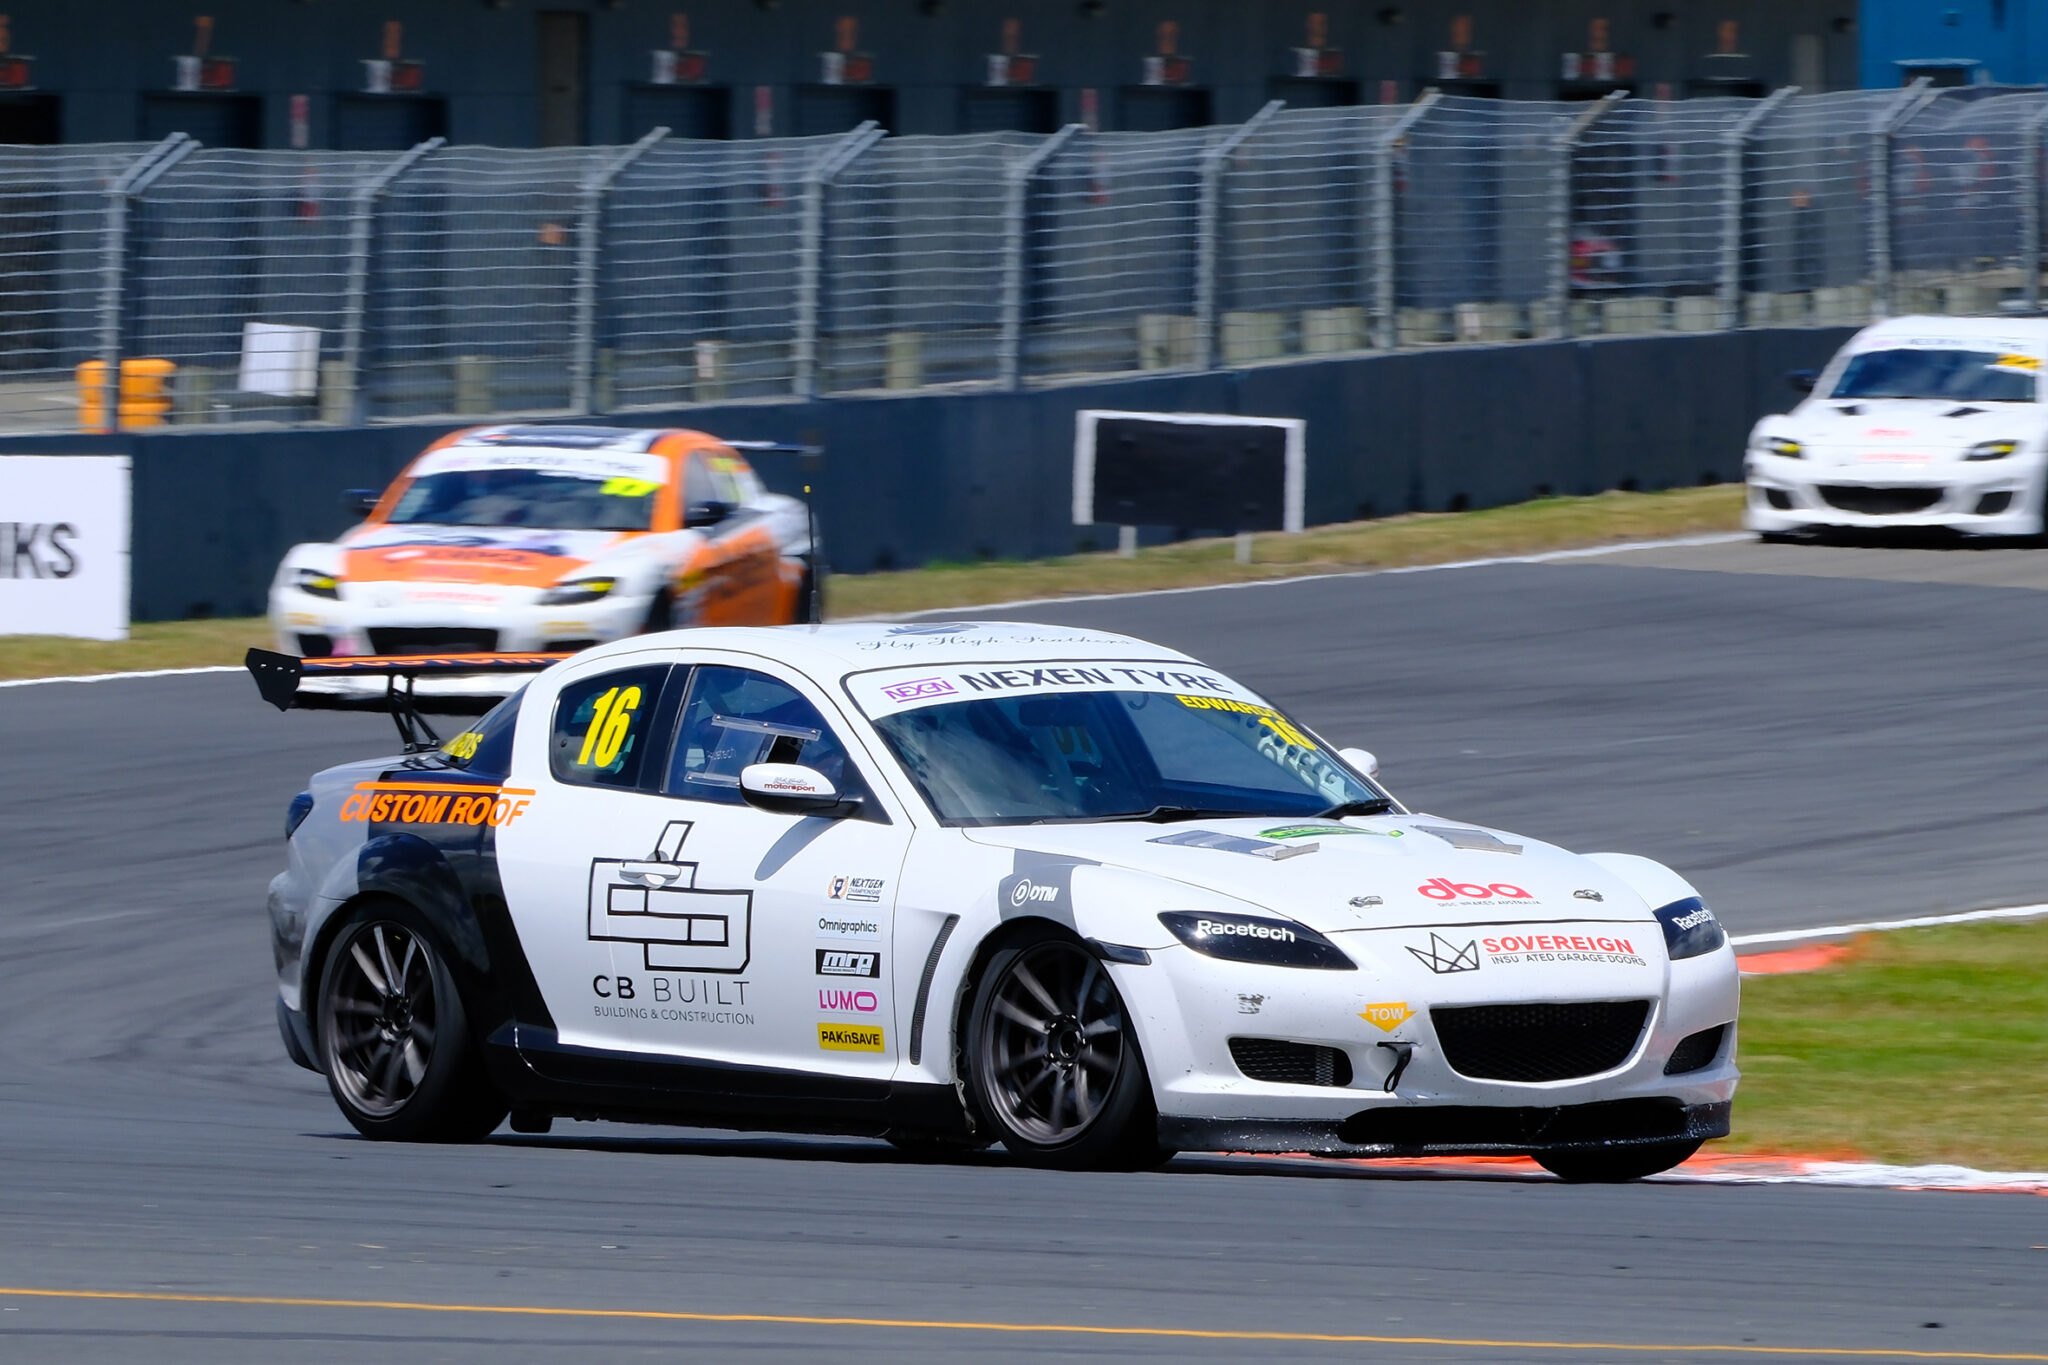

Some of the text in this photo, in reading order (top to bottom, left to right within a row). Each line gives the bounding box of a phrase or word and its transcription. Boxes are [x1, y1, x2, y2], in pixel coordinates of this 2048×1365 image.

[0, 521, 80, 579] KS
[884, 679, 956, 700] NEXEN
[959, 667, 1235, 695] NEXEN TYRE
[577, 686, 642, 768] 16
[339, 793, 531, 827] CUSTOM ROOF
[850, 877, 886, 889] NEXTGEN
[1029, 885, 1060, 902] DTM
[1417, 877, 1534, 900] dba
[818, 917, 878, 935] Omnigraphics
[1671, 906, 1713, 931] Racetech
[1196, 919, 1296, 943] Racetech
[1482, 935, 1635, 955] SOVEREIGN
[1491, 953, 1647, 967] INSUATED GARAGE DOORS
[592, 974, 750, 1006] CB BUILT
[818, 989, 878, 1012] LUMO
[594, 1005, 755, 1025] BUILDING & CONSTRUCTION
[1369, 1006, 1405, 1021] TOW
